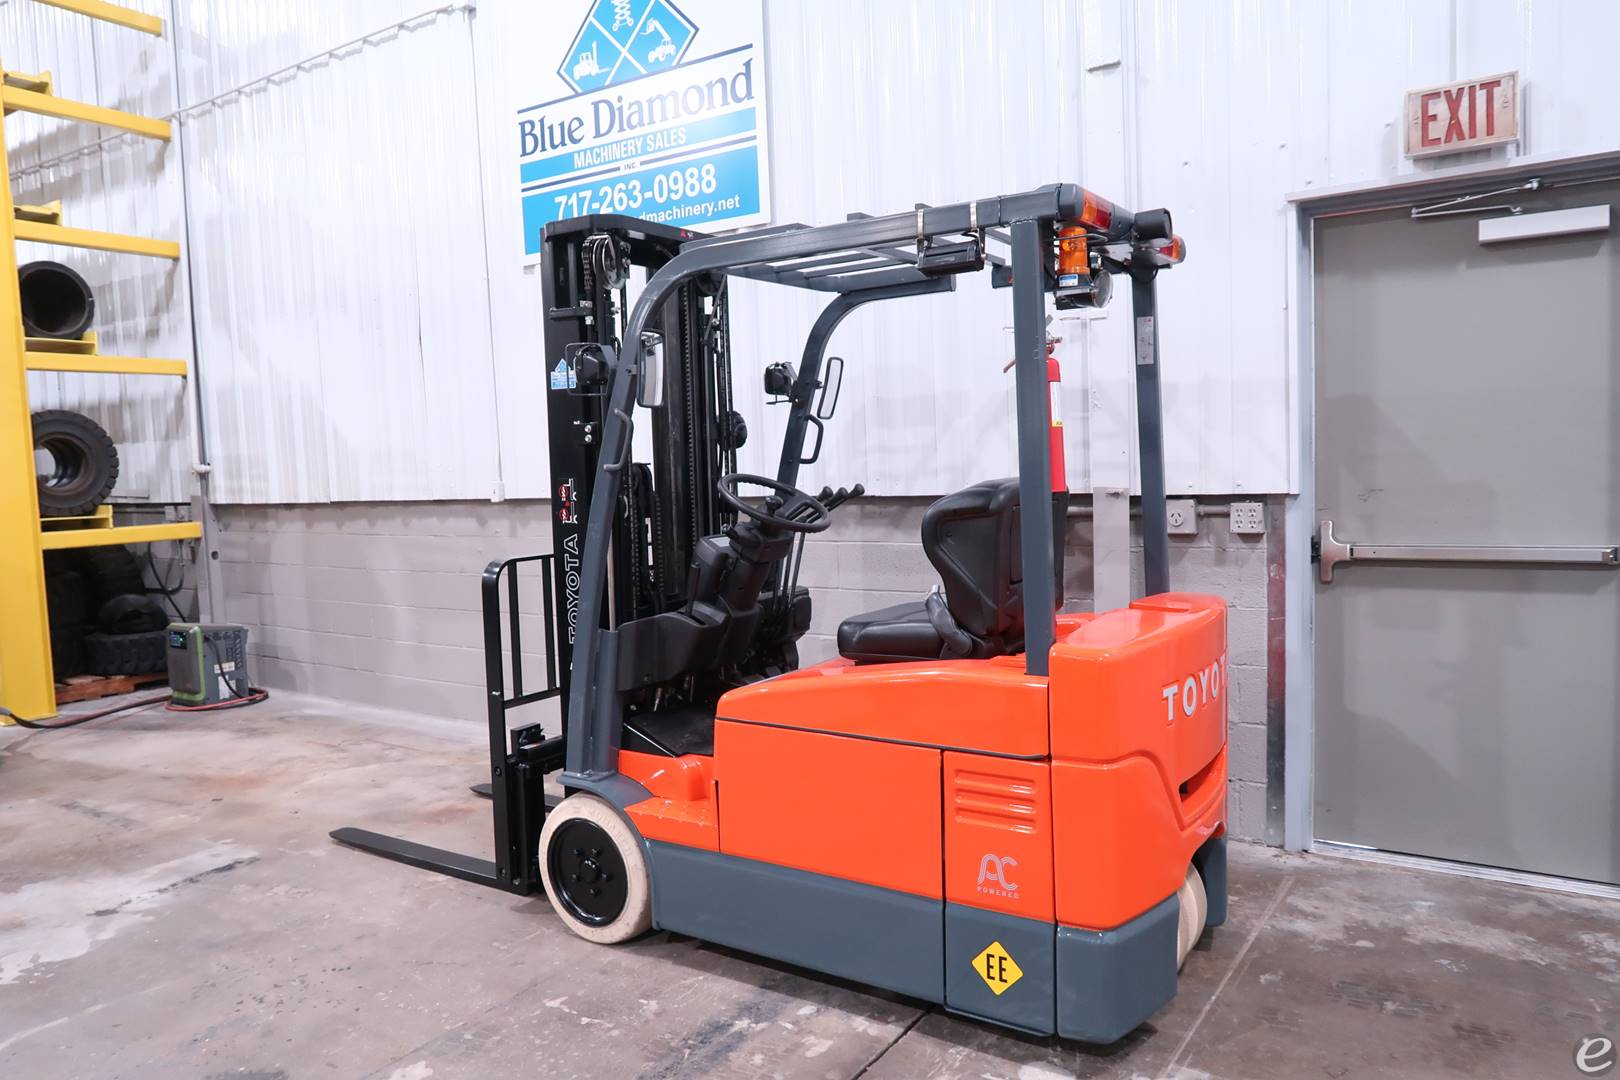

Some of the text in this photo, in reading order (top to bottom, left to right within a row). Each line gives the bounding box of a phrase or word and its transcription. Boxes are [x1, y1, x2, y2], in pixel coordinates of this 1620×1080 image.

[518, 57, 754, 158] Blue Diamond
[1421, 80, 1501, 147] EXIT
[573, 127, 687, 169] MACHINERY SALES
[554, 163, 717, 221] 717-263-0988
[635, 194, 740, 223] dmachinery.net
[977, 853, 1018, 891] AC
[976, 885, 1020, 900] POWERED
[986, 953, 1008, 983] EE
